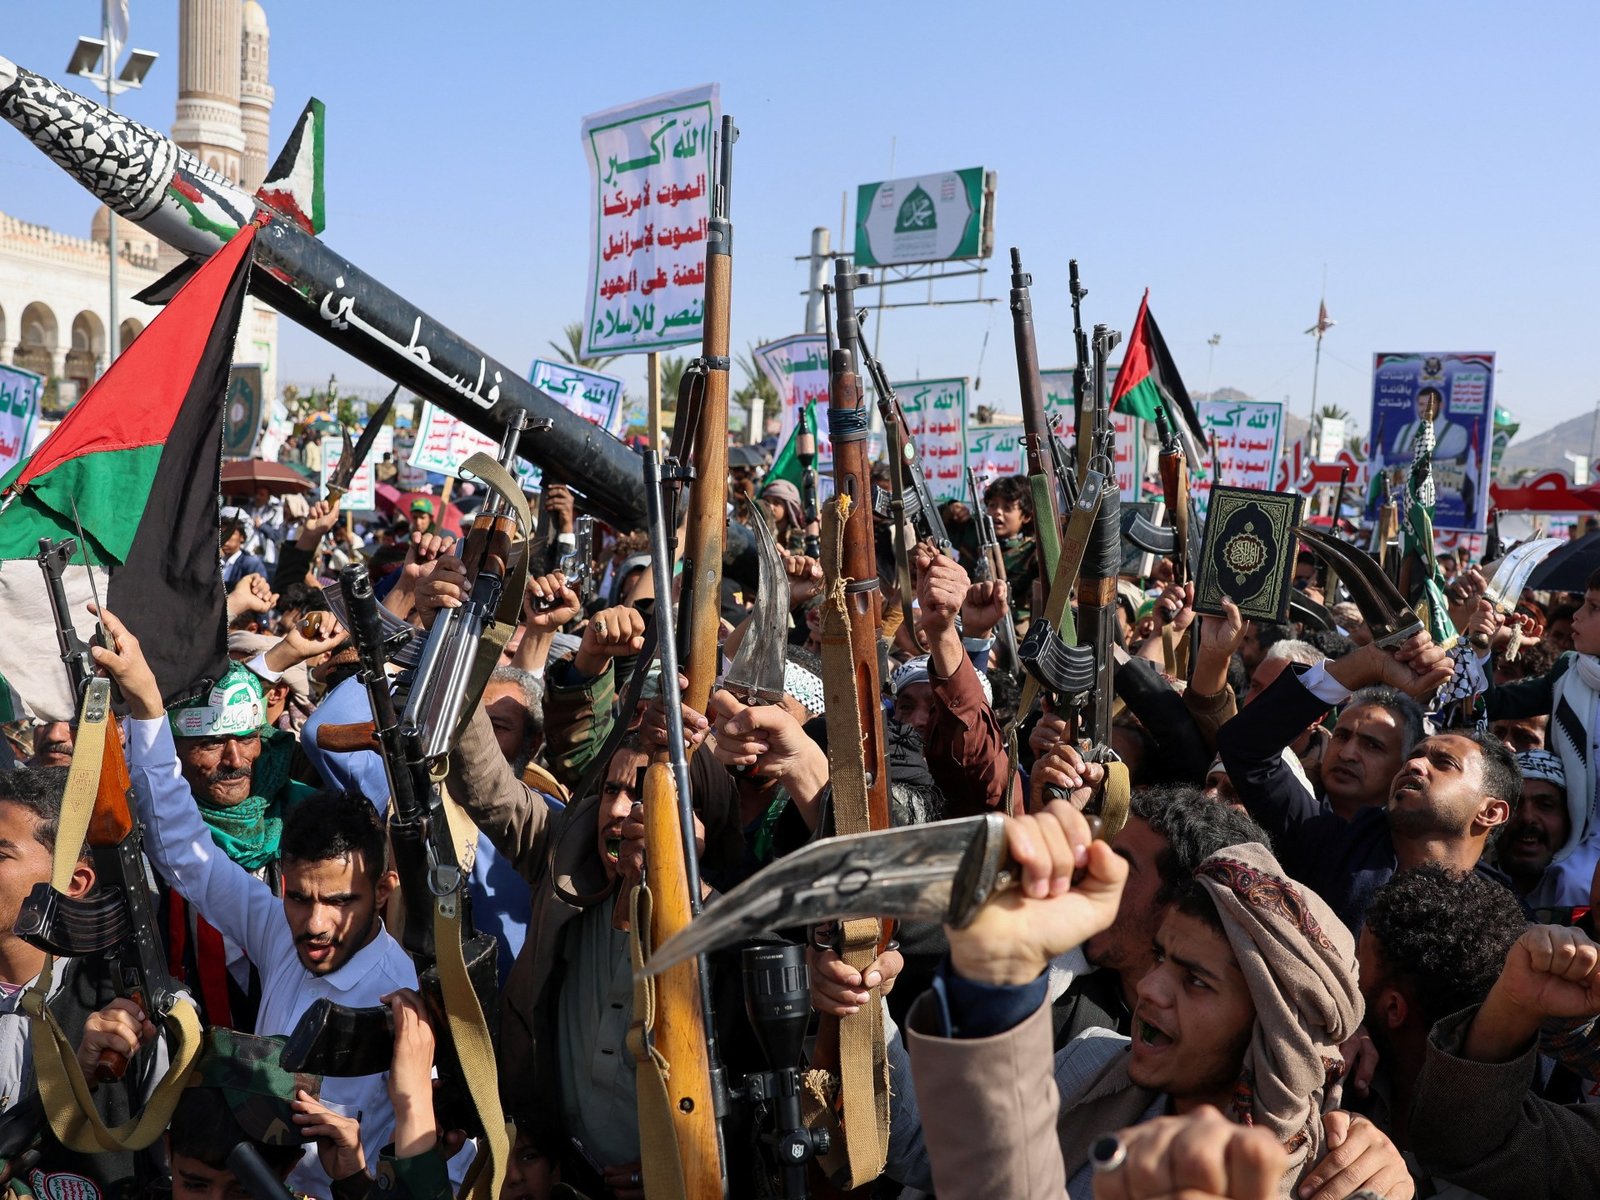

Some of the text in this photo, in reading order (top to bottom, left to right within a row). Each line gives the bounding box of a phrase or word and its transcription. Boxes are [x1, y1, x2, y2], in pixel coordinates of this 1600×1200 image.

[602, 116, 706, 188] الله أكبر
[656, 173, 706, 208] الموت
[657, 217, 708, 251] الموت
[599, 262, 705, 301] للعنة على اليهود
[655, 297, 703, 337] لنصر
[320, 275, 503, 410] فلسطين
[538, 374, 614, 404] الله أكبر
[901, 387, 960, 413] الله أك
[929, 418, 960, 436] الموت
[1202, 404, 1277, 432] الله أكبر
[929, 441, 962, 460] الموت
[969, 431, 1020, 453] الله أك
[1239, 437, 1273, 452] الموت
[1236, 459, 1270, 474] الموت
